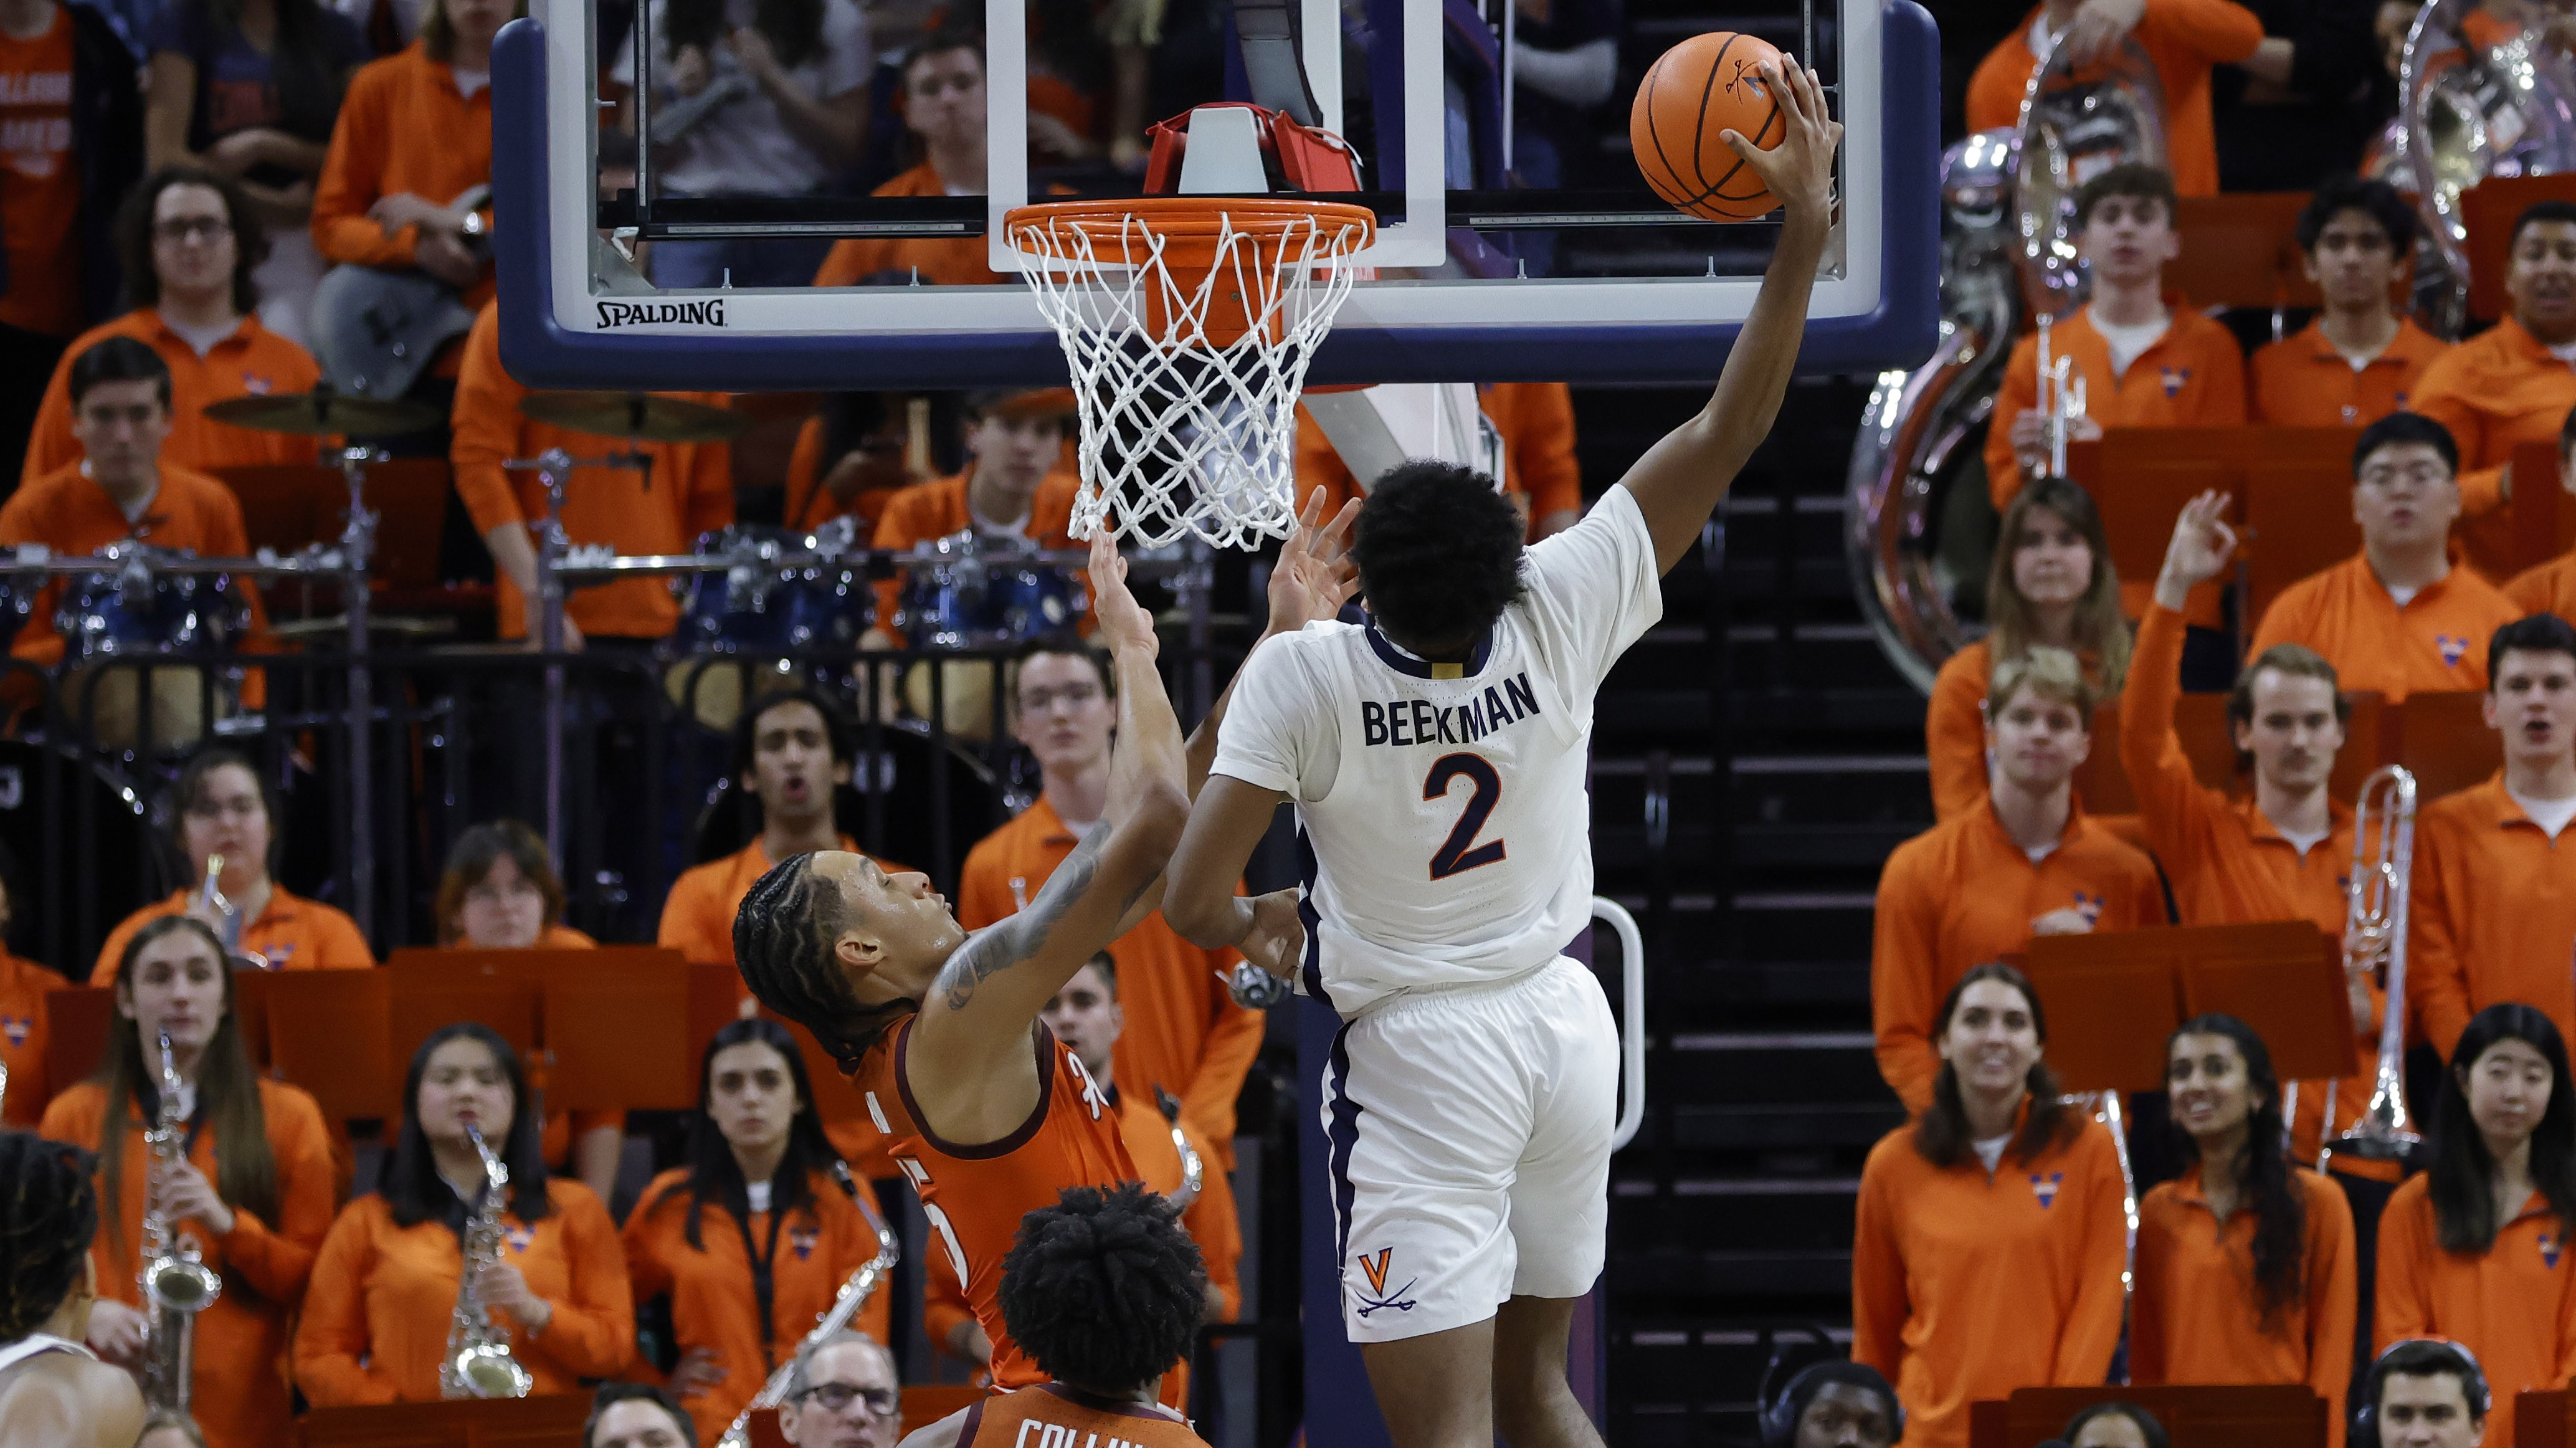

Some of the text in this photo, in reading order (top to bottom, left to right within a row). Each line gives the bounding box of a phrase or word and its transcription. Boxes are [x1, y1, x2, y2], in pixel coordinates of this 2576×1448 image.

[597, 298, 724, 329] SPALDING
[1362, 672, 1540, 746] BEEKMAN
[1423, 751, 1506, 881] 2
